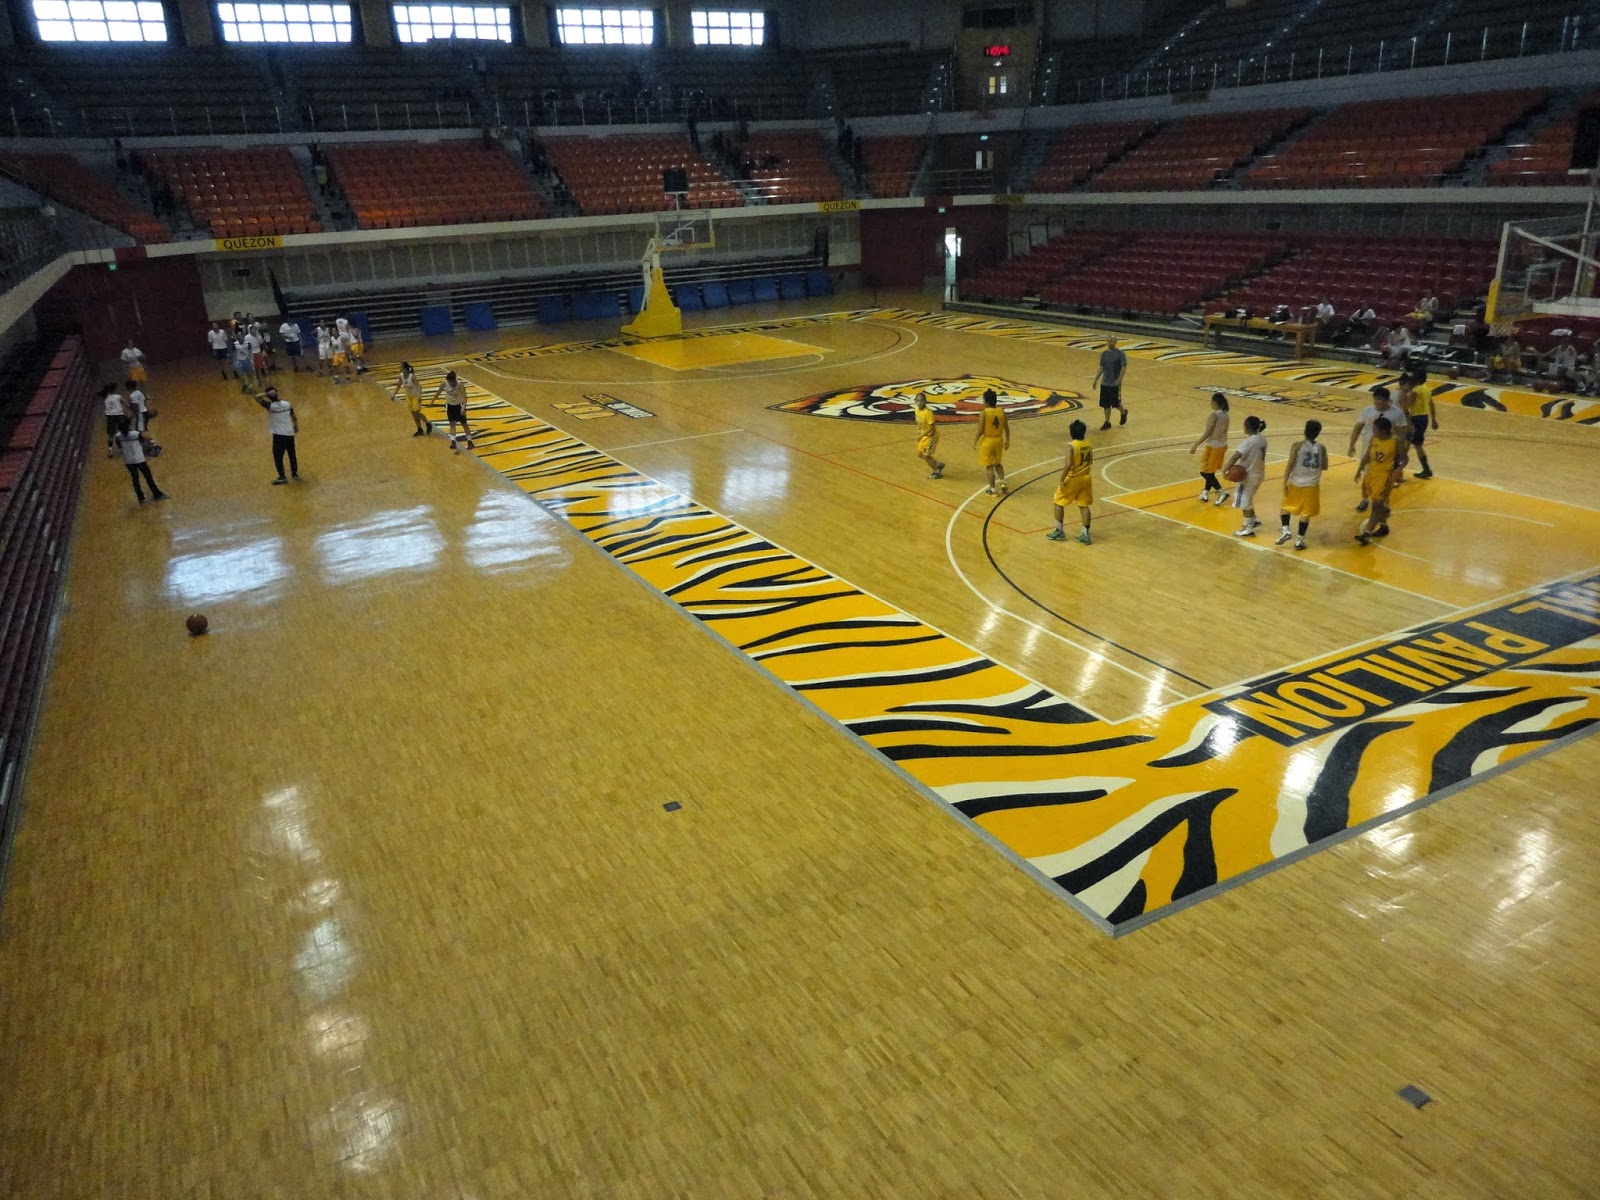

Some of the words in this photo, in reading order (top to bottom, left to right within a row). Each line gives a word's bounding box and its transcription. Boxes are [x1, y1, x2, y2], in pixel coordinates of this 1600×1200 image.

[824, 202, 857, 211] QUEZON
[224, 237, 275, 249] QUEZON
[993, 416, 1000, 429] 4
[1079, 452, 1091, 466] 14
[1302, 452, 1320, 468] 23
[1223, 620, 1550, 738] PAVILION
